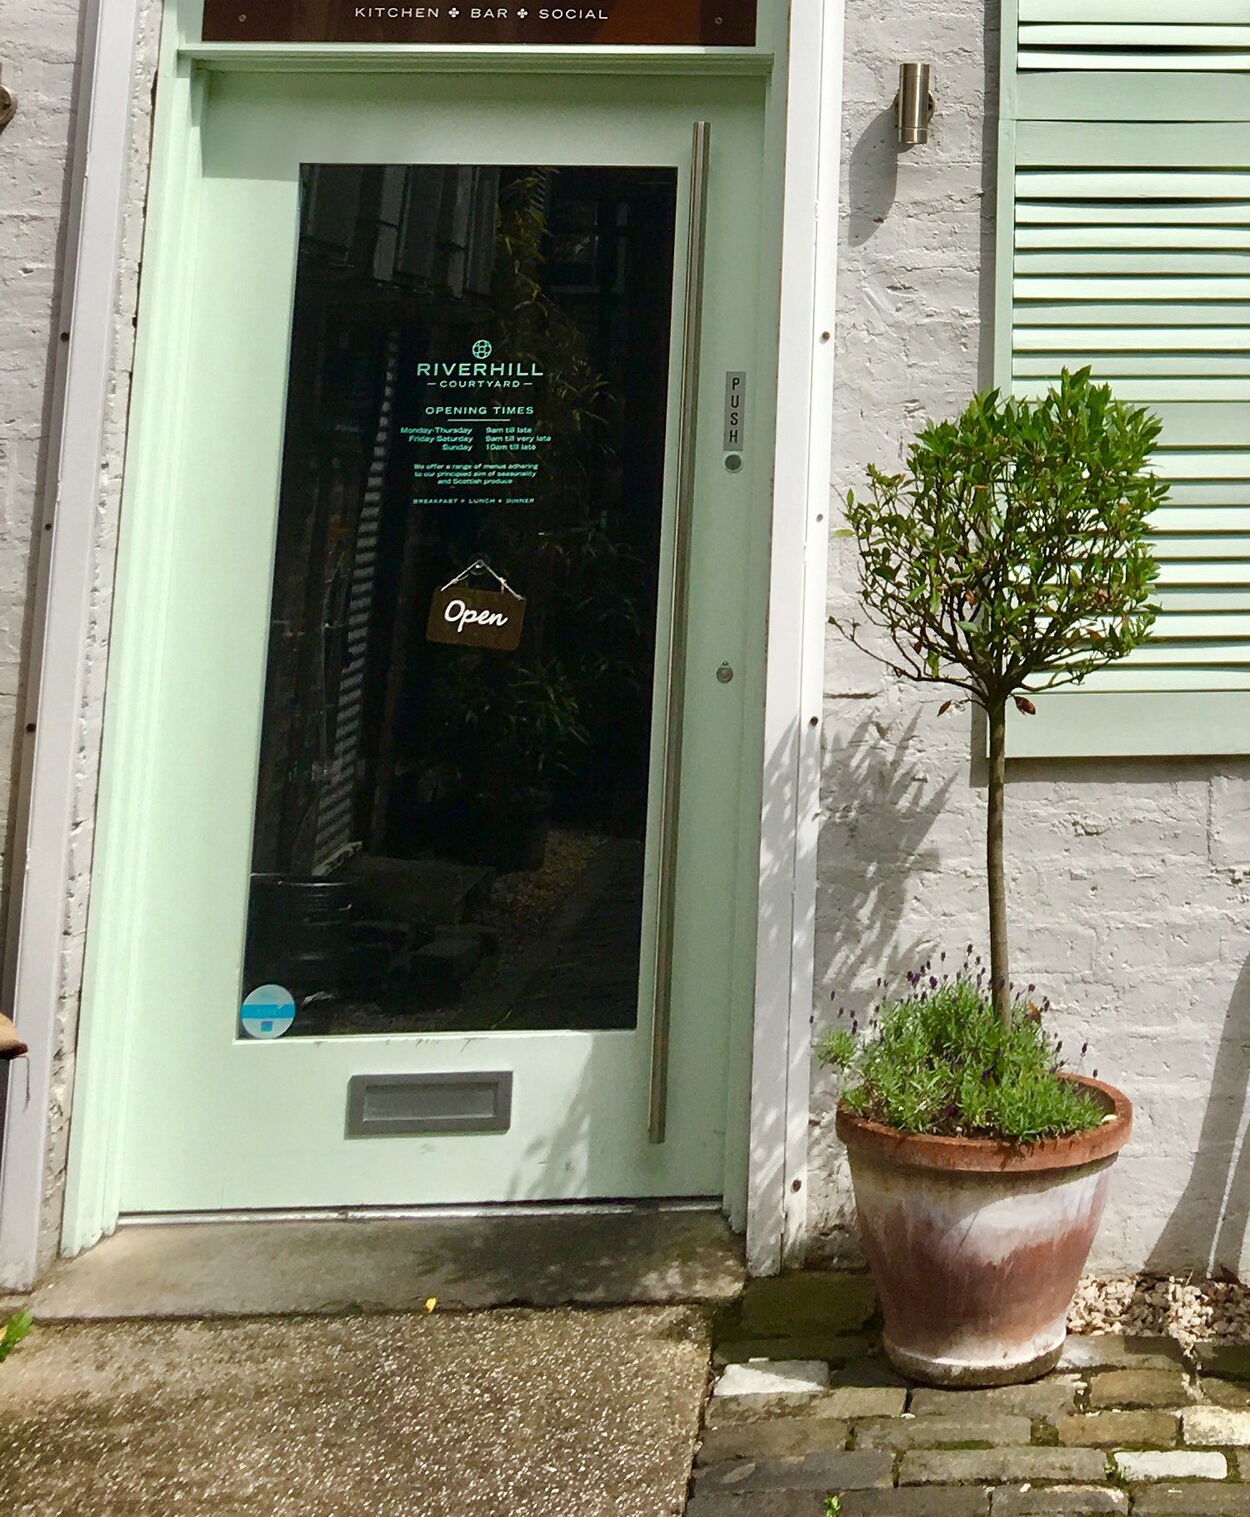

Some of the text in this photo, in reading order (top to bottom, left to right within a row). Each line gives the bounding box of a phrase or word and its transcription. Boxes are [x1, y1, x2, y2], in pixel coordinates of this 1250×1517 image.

[354, 7, 609, 21] KITCHEN BAR SOCIAL
[416, 362, 544, 377] RIVERHILL
[439, 380, 520, 388] COURTYARD
[425, 406, 535, 415] OPENING TIMES
[729, 377, 741, 444] PUSH
[485, 426, 504, 434] 9am
[517, 426, 533, 434] late
[485, 434, 503, 442] 9am
[536, 434, 552, 442] late
[442, 443, 473, 452] Sunday
[486, 443, 508, 451] 10am
[444, 599, 508, 633] Open
